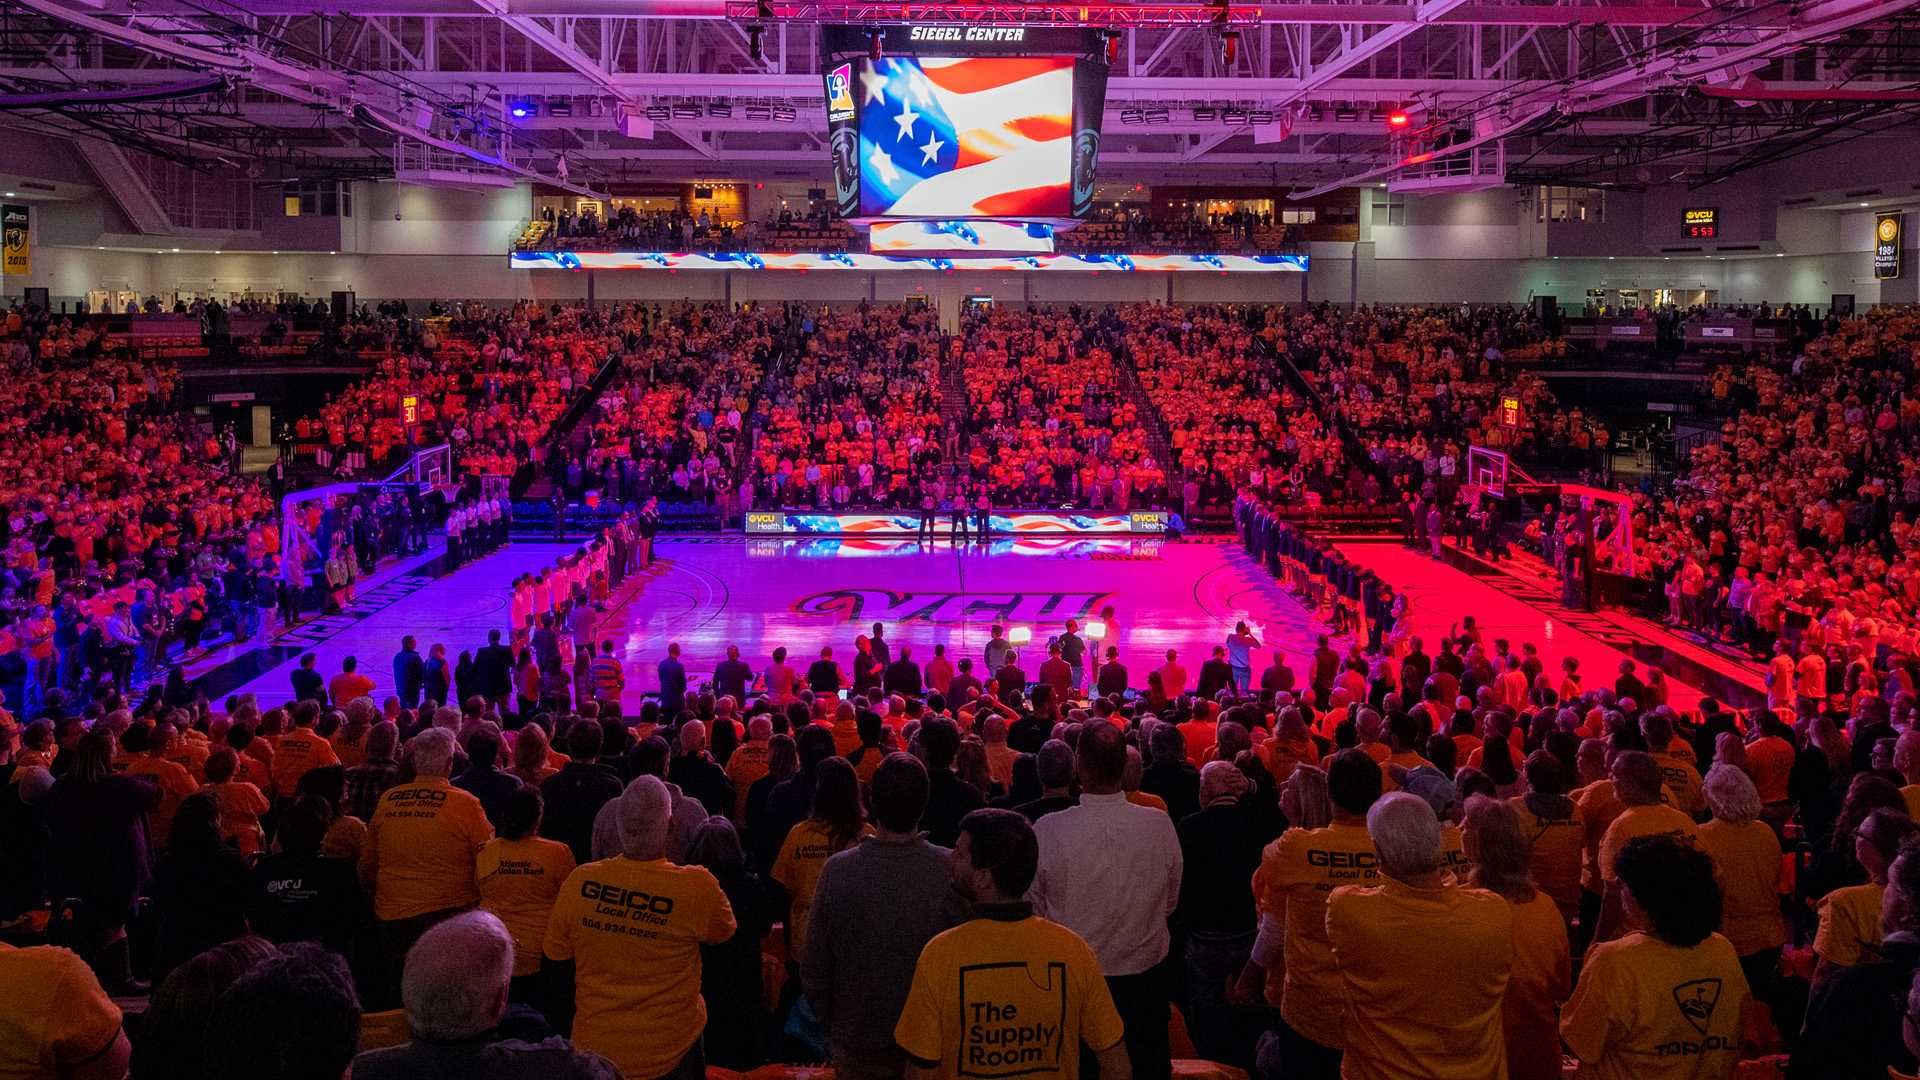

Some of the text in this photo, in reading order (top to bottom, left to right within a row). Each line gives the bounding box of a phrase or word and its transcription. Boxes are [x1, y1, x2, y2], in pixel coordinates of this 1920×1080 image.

[910, 26, 1025, 41] SIEGEL CENTER
[1694, 211, 1713, 219] VCU
[8, 256, 28, 266] 2015
[405, 406, 415, 423] 30
[1506, 409, 1516, 425] 30
[756, 514, 775, 523] VCU
[1140, 514, 1159, 522] VCU
[794, 589, 1110, 624] VCU
[280, 740, 312, 749] GEICO
[388, 788, 447, 801] GEICO
[395, 800, 444, 809] Local Office
[802, 851, 826, 859] Union
[1307, 849, 1378, 869] GEIC
[498, 867, 545, 875] Union Bank
[500, 860, 532, 868] Atlantic
[1328, 869, 1360, 879] Local
[581, 880, 674, 914] GEICO
[595, 902, 668, 925] Local Office
[582, 917, 658, 939] 804.934.0222
[970, 1001, 1017, 1022] The
[969, 1022, 1056, 1048] Supply
[969, 1046, 1042, 1066] Room
